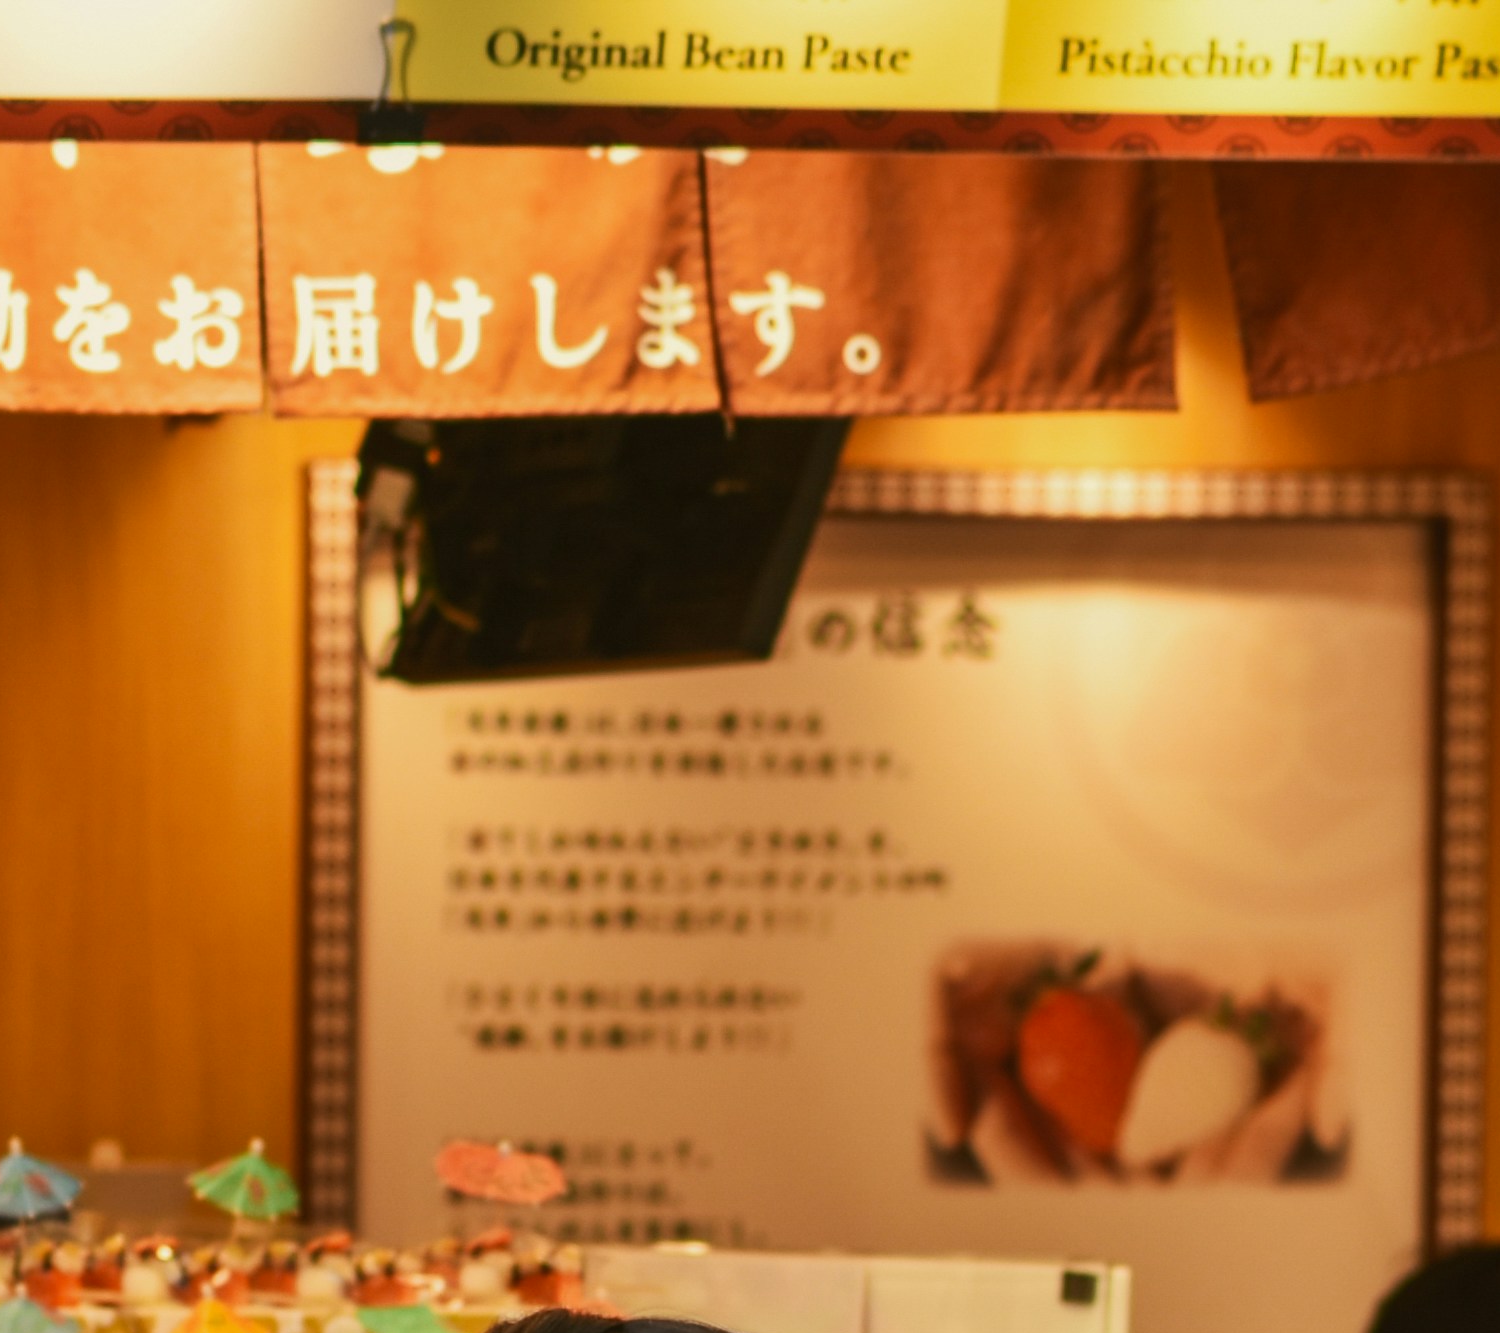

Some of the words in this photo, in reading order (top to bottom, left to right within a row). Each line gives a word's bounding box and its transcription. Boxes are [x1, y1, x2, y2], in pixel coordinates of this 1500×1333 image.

[486, 27, 666, 82] Original
[683, 32, 785, 72] Bean
[802, 35, 911, 76] Paste
[1286, 37, 1416, 81] Flavor
